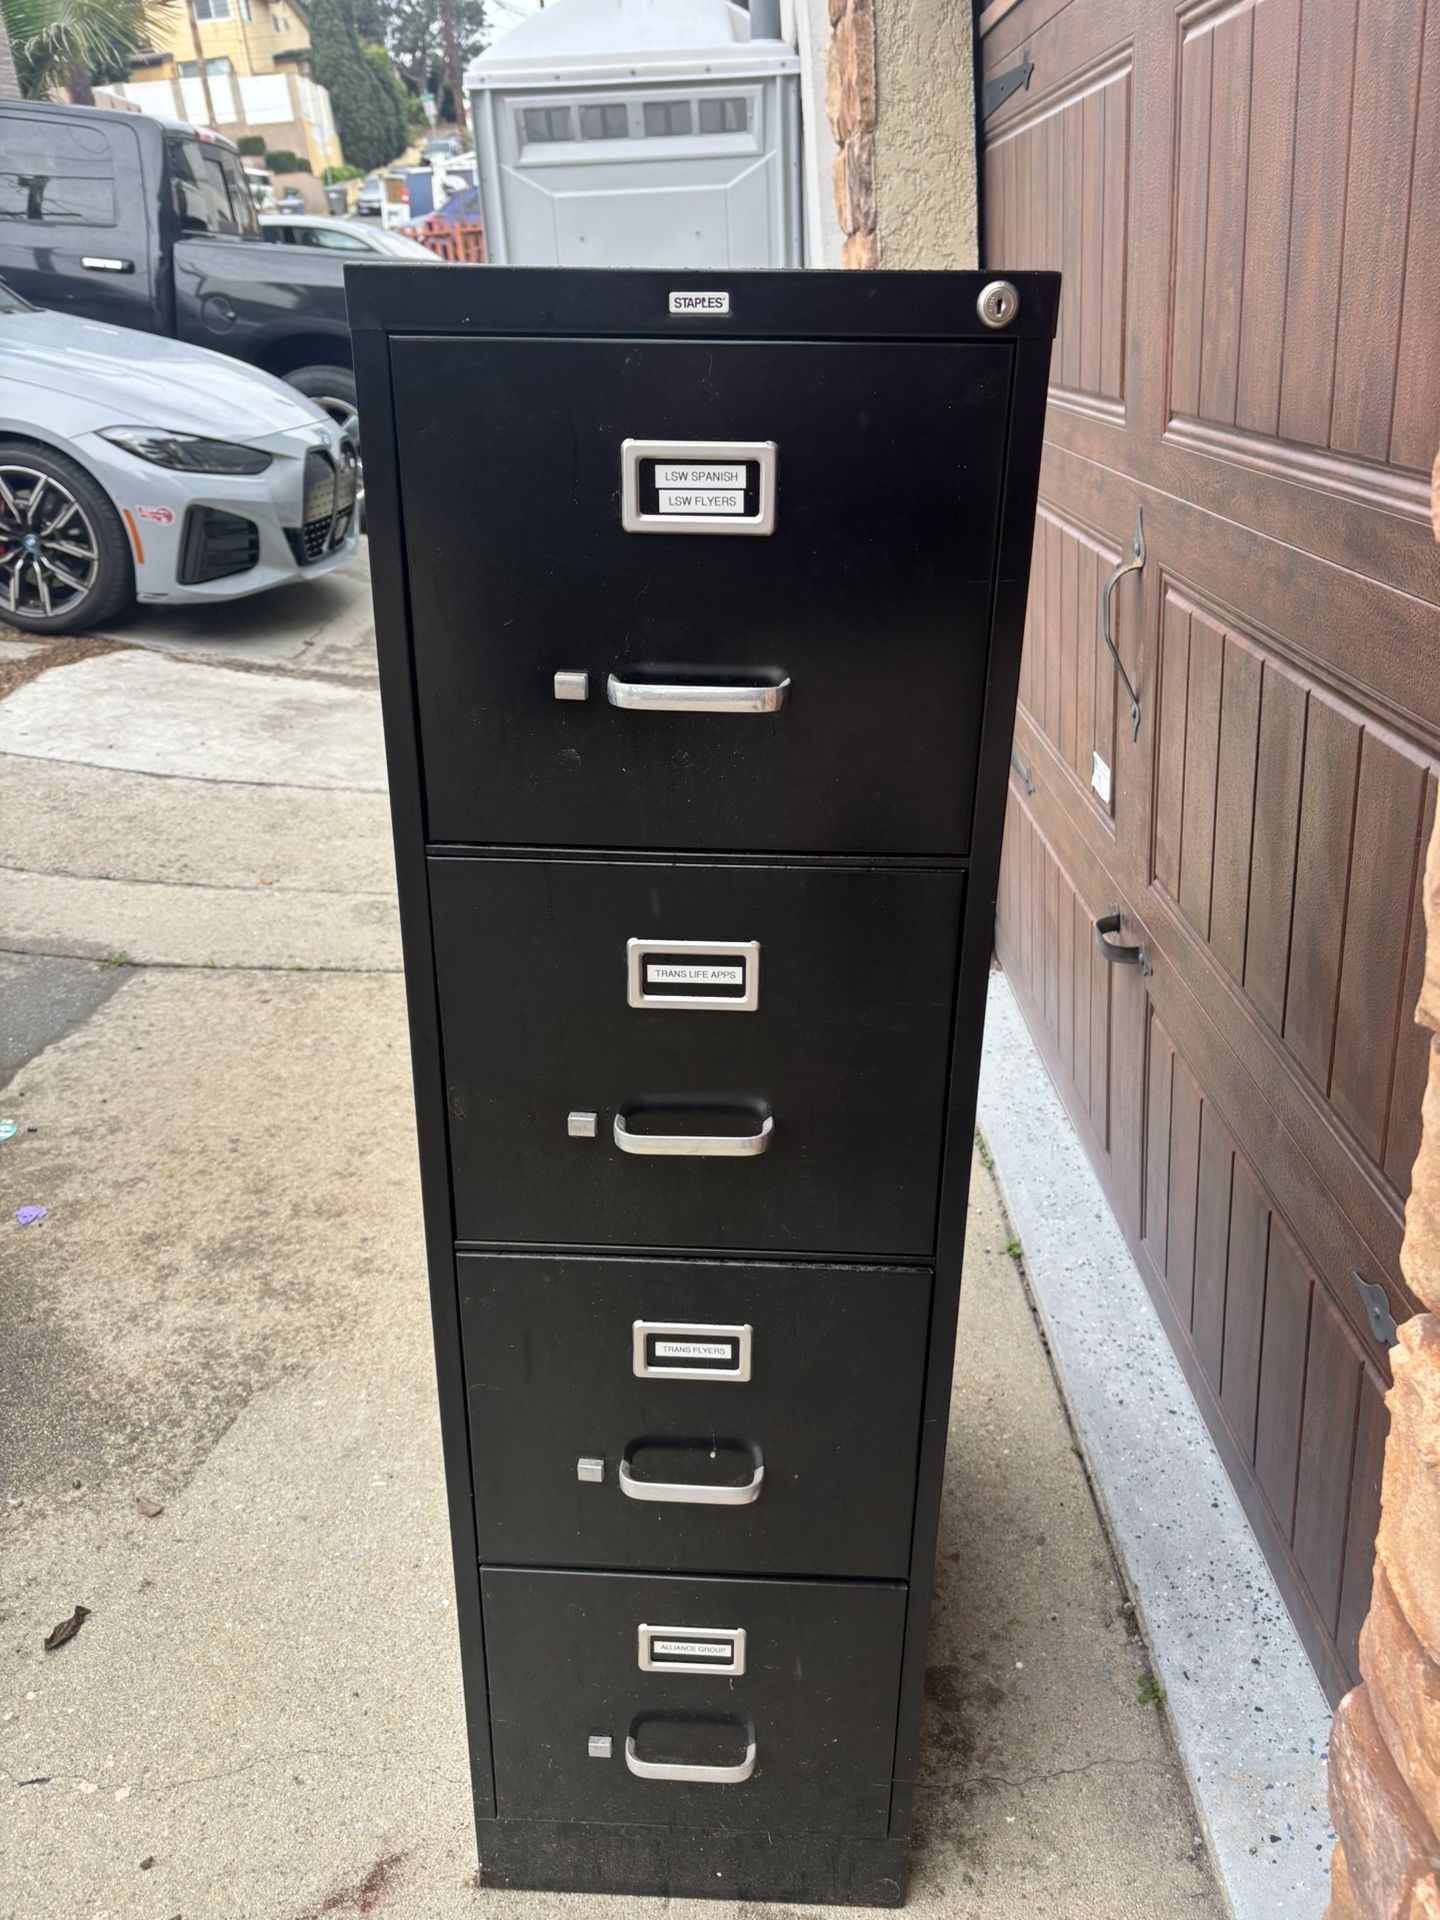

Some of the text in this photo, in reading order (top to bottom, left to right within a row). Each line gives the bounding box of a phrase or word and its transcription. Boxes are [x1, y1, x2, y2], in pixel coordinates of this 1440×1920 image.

[674, 297, 724, 309] STAPLES
[665, 471, 738, 482] LSW SPANISH
[668, 496, 737, 507] LSW FLYERS
[655, 969, 736, 979] TRANS LIFE APPS
[663, 1345, 726, 1355] TRANS FLYERS
[660, 1644, 697, 1652] ALLIANCE
